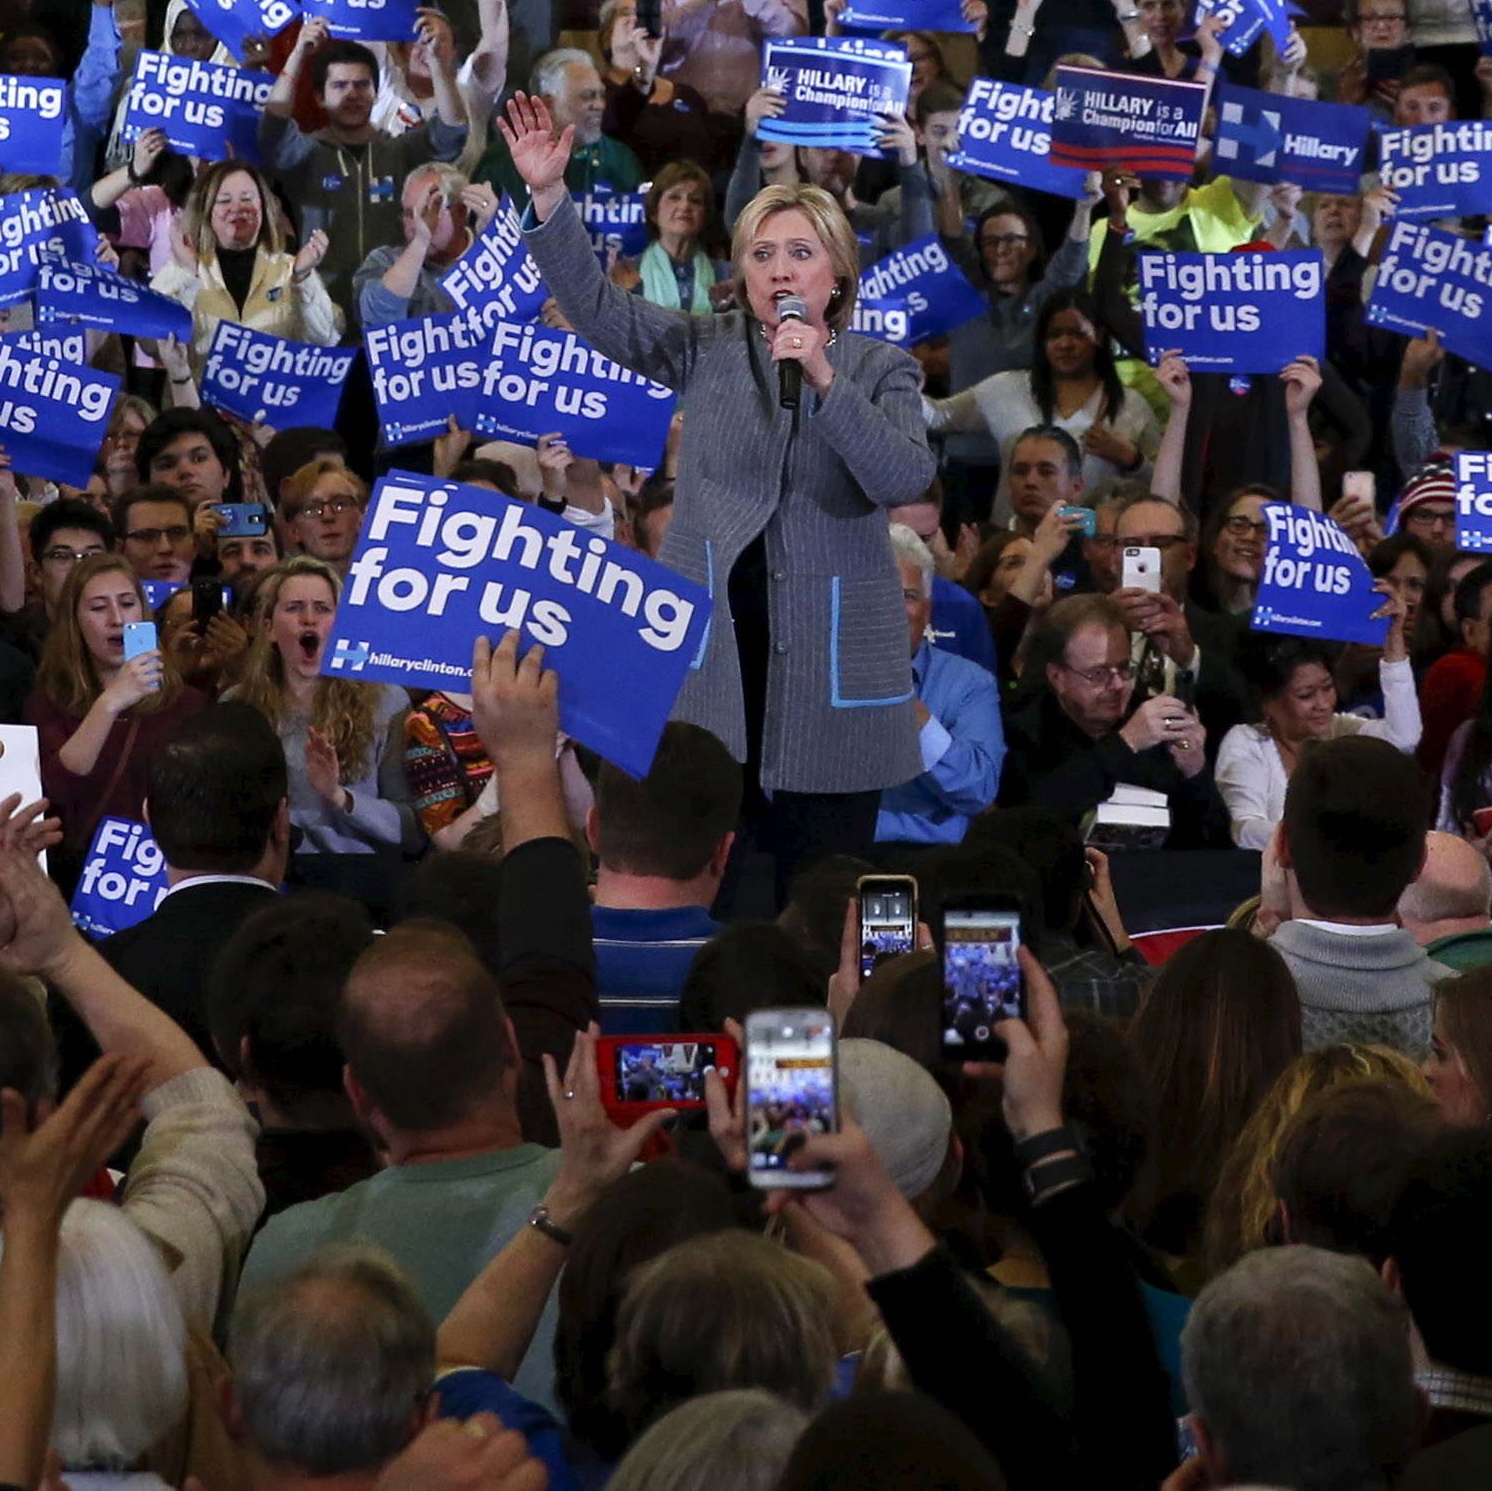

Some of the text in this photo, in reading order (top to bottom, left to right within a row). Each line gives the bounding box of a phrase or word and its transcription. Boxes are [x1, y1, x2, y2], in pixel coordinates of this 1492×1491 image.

[798, 68, 866, 94] HILLARY
[1084, 90, 1153, 116] HILLARY
[1156, 100, 1169, 117] is
[1284, 132, 1358, 165] Hillary
[1142, 254, 1320, 305] Fighting
[1143, 293, 1260, 331] for us
[363, 485, 694, 650] Fighting
[349, 542, 571, 649] for us
